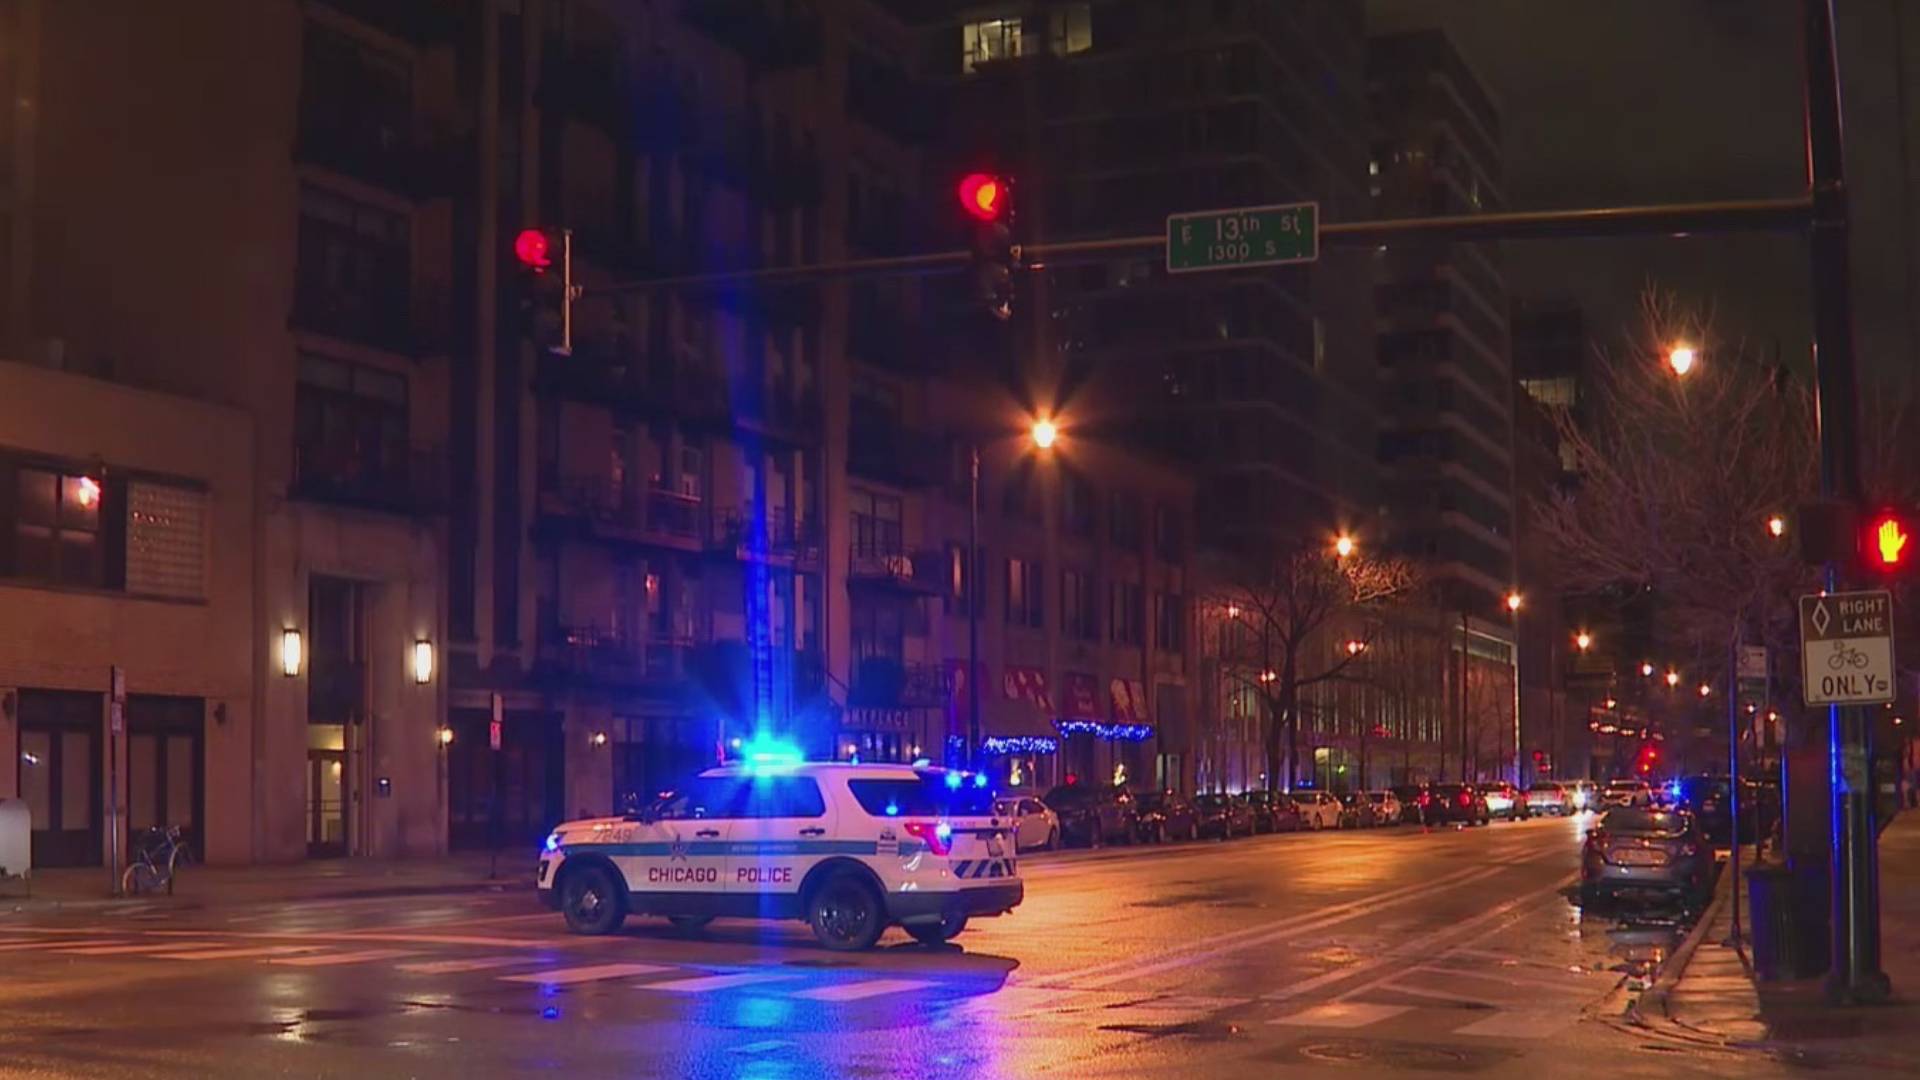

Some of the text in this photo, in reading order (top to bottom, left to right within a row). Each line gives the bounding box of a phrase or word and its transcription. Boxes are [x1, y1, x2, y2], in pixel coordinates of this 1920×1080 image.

[1182, 214, 1301, 246] E 13th St
[1208, 239, 1277, 262] 1300 S
[1839, 599, 1885, 615] RIGHT
[1842, 618, 1883, 633] LANE
[1822, 673, 1875, 696] ONLY
[648, 866, 793, 883] CHICAGO POLICE
